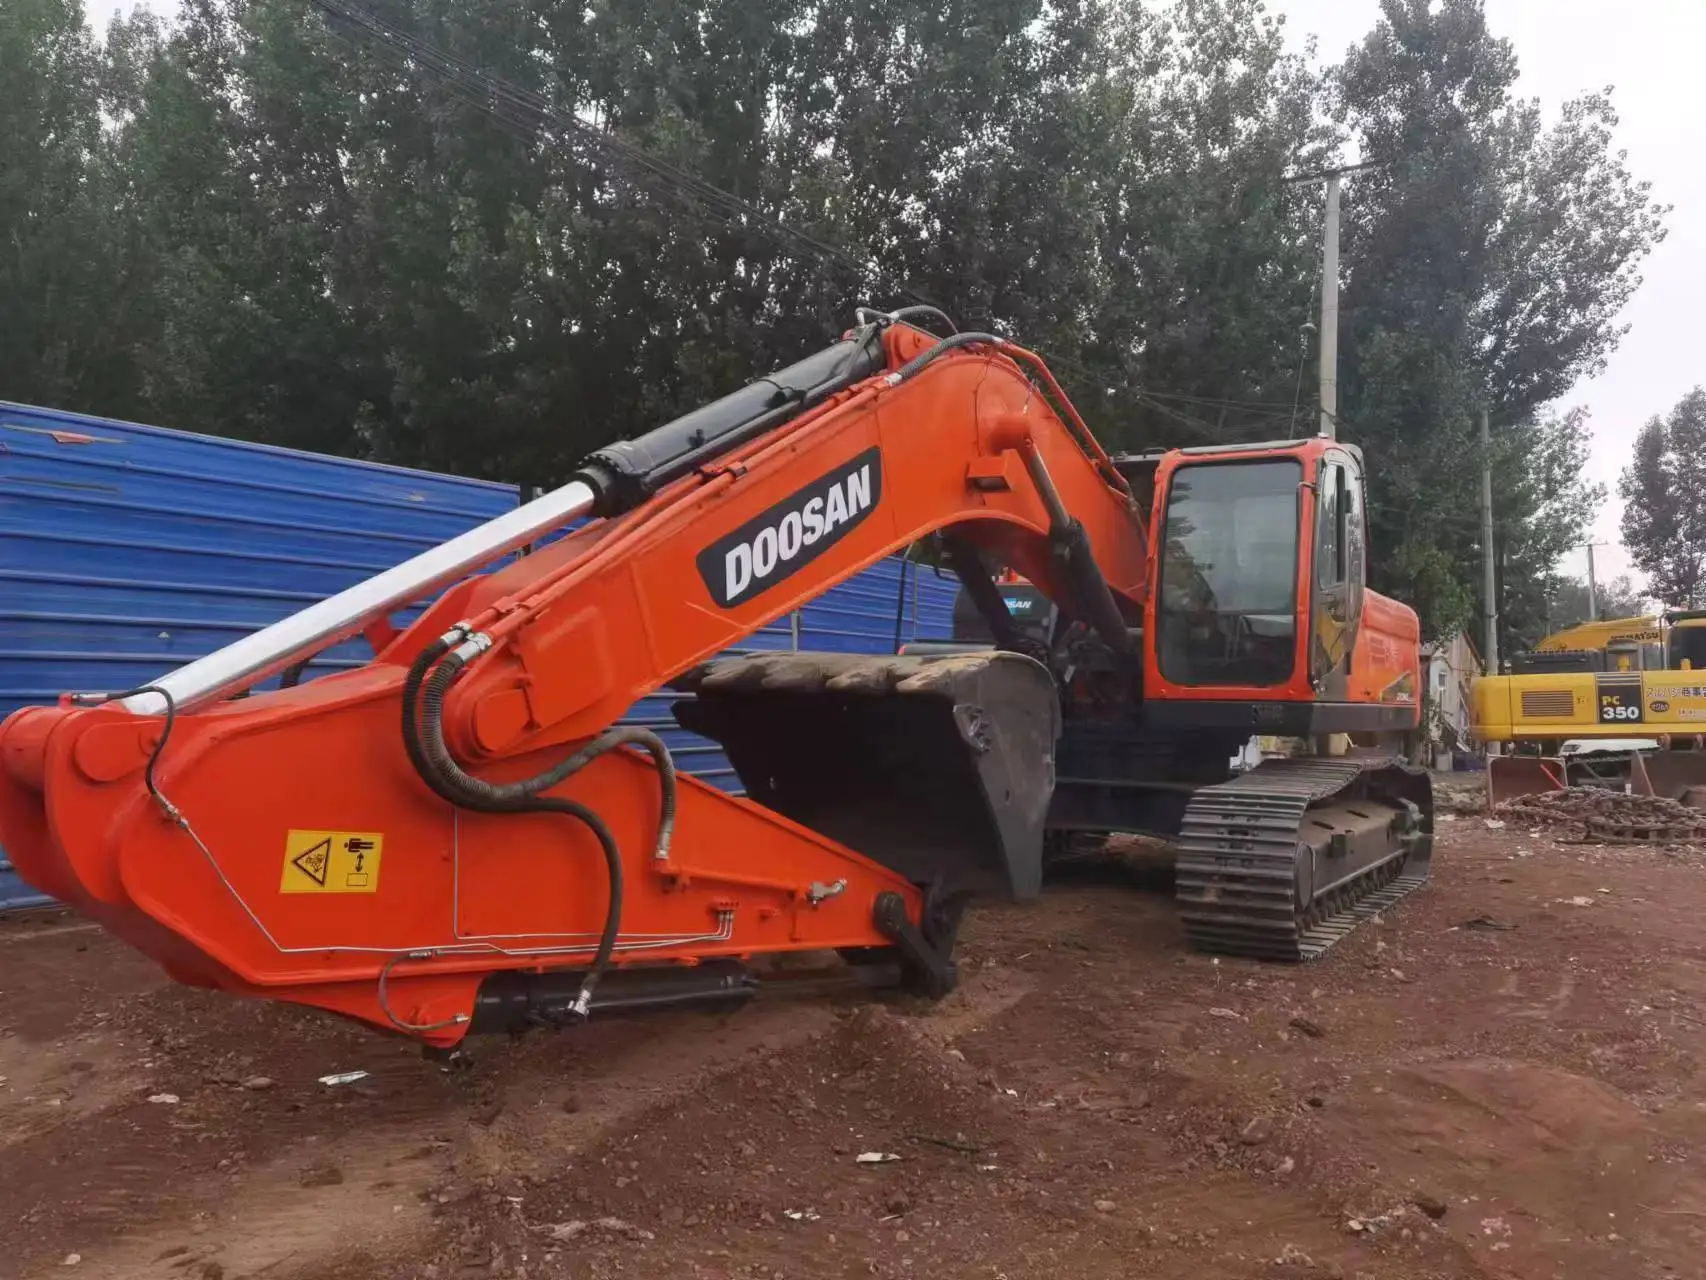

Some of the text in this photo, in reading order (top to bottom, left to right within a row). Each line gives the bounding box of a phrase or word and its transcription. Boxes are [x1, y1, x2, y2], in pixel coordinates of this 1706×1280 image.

[725, 464, 871, 601] DOOSAN
[1602, 695, 1619, 705] PC
[1603, 706, 1639, 720] 350
